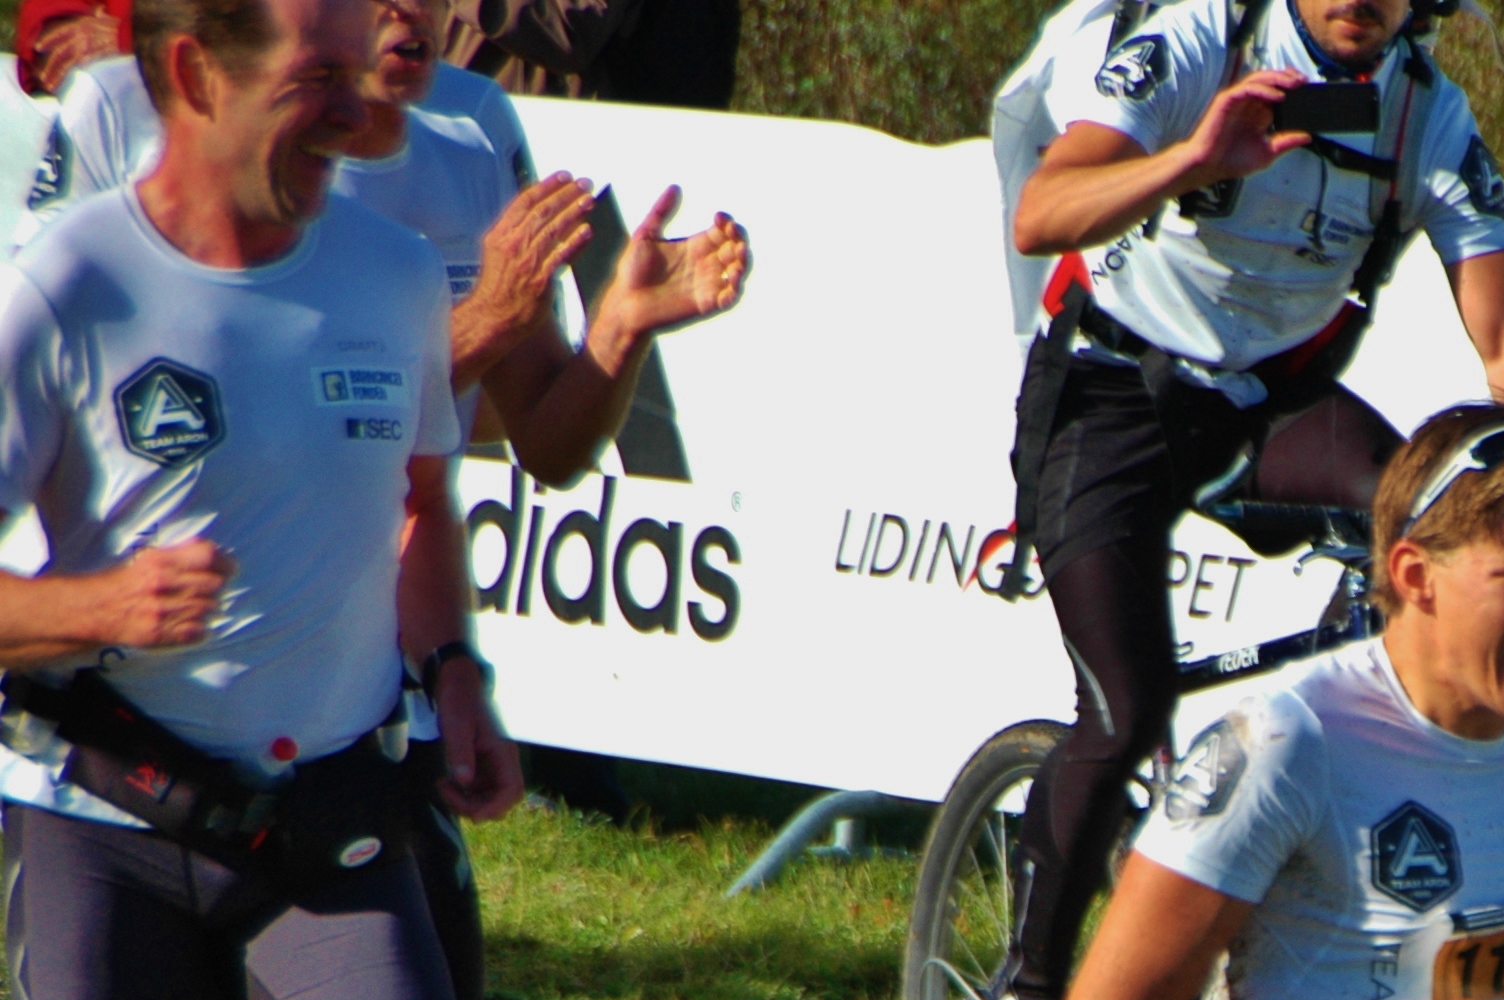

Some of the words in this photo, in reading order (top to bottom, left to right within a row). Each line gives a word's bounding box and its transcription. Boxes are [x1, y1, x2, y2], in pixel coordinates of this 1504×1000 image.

[139, 374, 206, 438] A
[366, 418, 403, 441] SEC
[466, 464, 742, 643] didas
[1390, 816, 1449, 877] A
